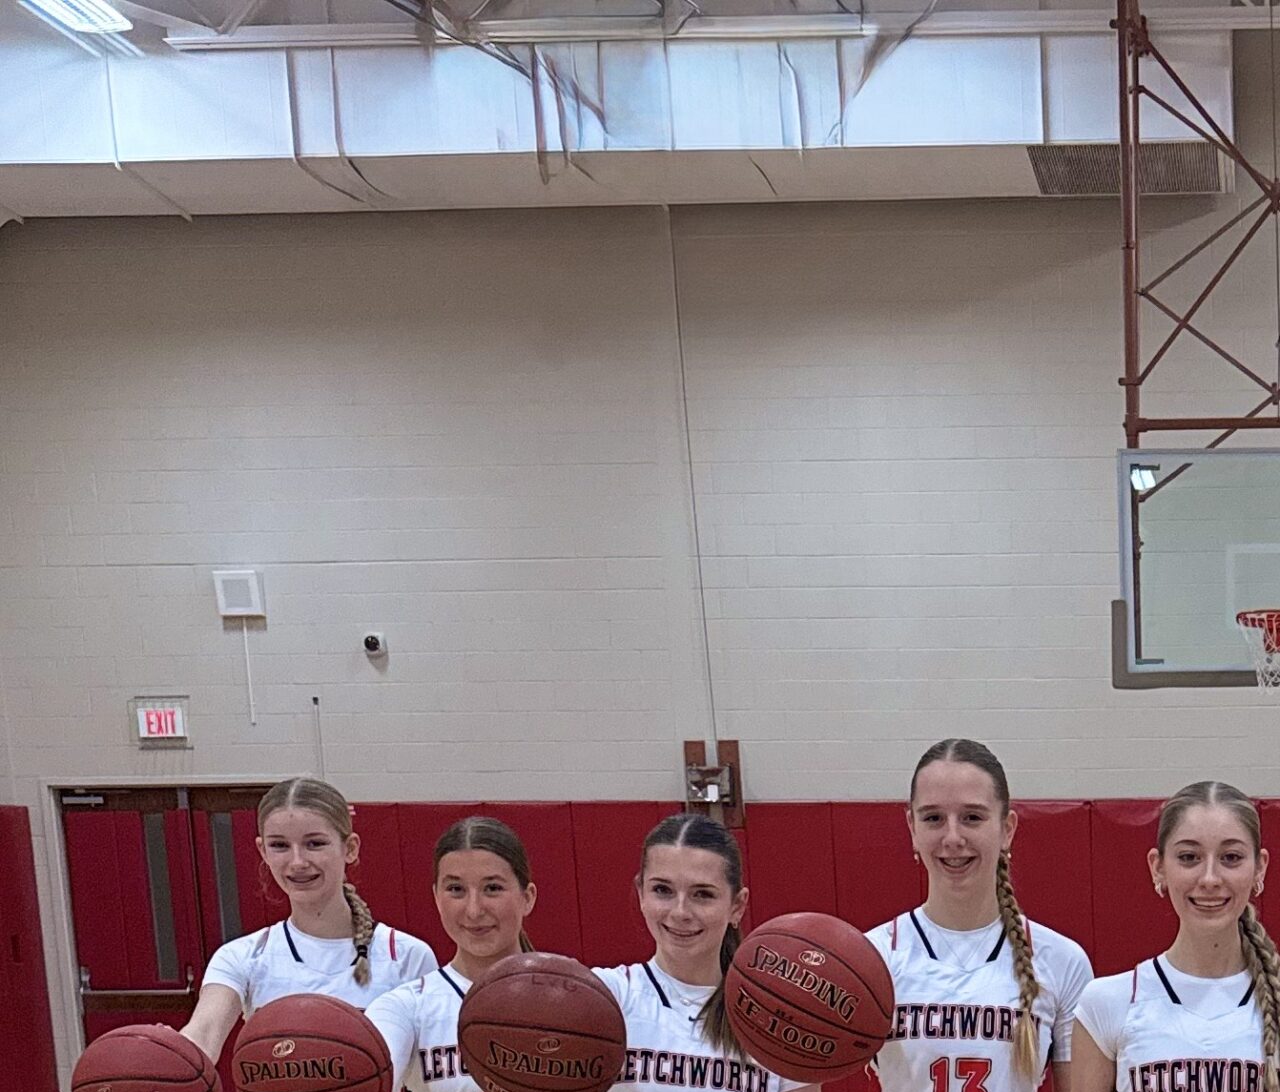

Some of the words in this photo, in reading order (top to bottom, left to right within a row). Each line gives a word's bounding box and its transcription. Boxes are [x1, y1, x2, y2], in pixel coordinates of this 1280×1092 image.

[145, 709, 176, 735] EXIT
[748, 944, 860, 1023] SPALDING
[884, 1003, 1041, 1042] ETCHWOR
[239, 1054, 347, 1086] SPALDING
[487, 1040, 605, 1079] SPALDING
